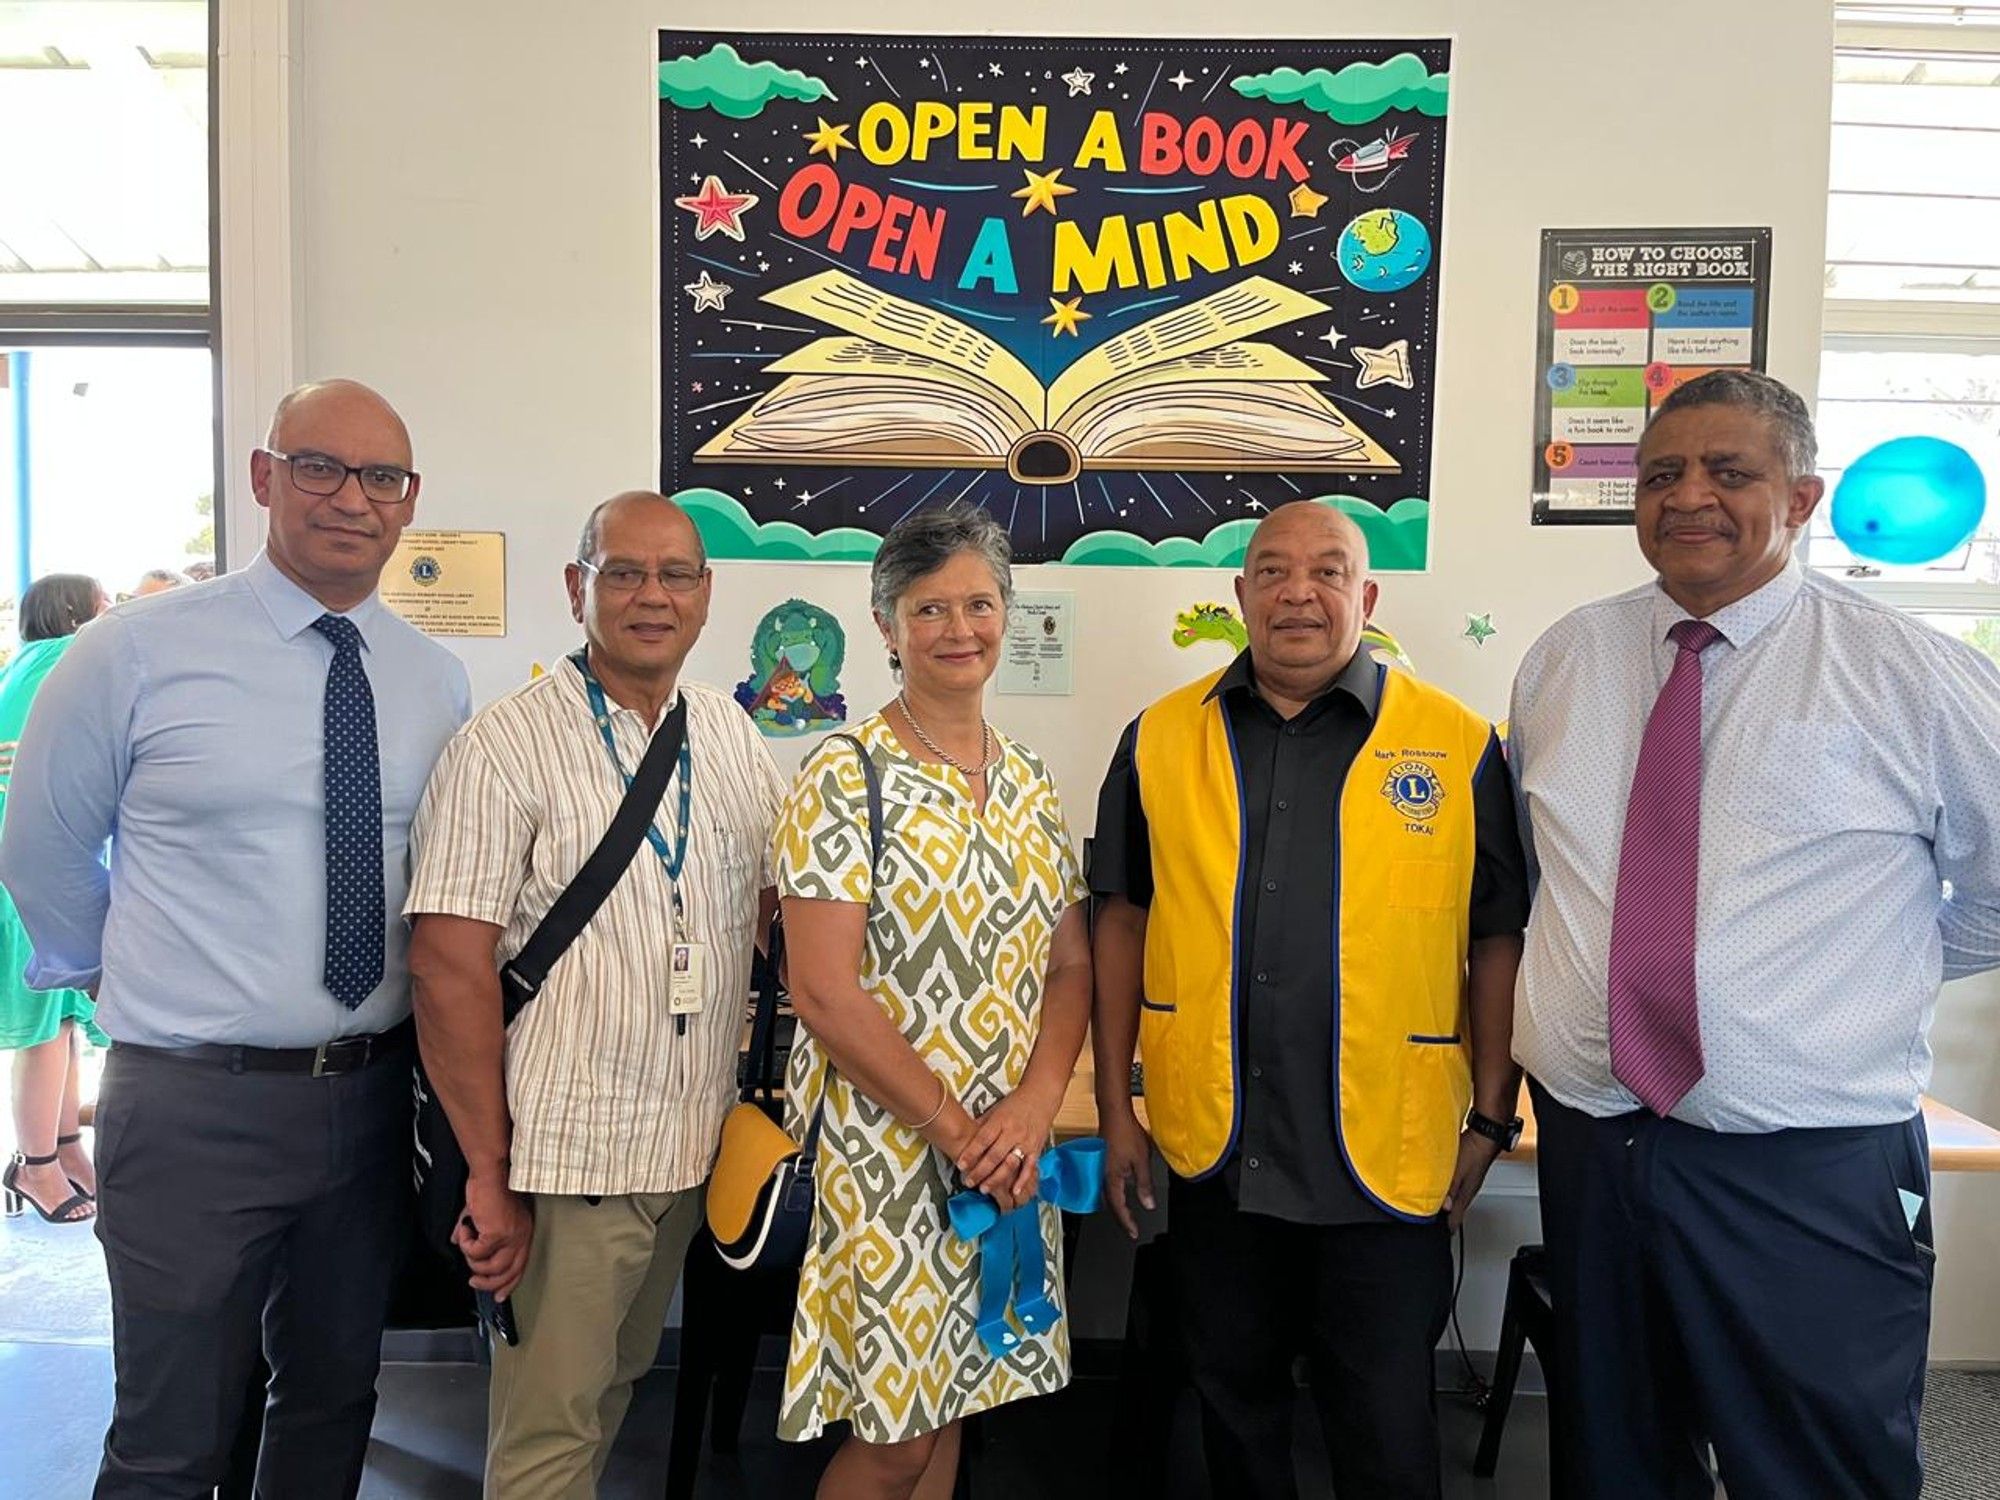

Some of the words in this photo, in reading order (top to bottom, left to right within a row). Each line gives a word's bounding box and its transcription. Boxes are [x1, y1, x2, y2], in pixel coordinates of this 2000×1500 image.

[858, 101, 1047, 165] OPEN
[1073, 110, 1127, 172] A
[1139, 112, 1310, 182] BOOK
[778, 163, 946, 280] OPEN
[957, 217, 1019, 294] A
[1052, 193, 1280, 294] MIND
[1591, 246, 1636, 261] HOW
[1640, 246, 1665, 260] TO
[1670, 246, 1744, 260] CHOOSE
[1591, 262, 1628, 276] THE
[1633, 262, 1691, 276] RIGHT
[1695, 262, 1749, 276] BOOK
[1558, 287, 1569, 309] 1
[1653, 286, 1668, 308] 2
[1710, 337, 1739, 346] anything
[1586, 347, 1625, 356] interesting?
[1668, 346, 1679, 354] like
[1682, 346, 1694, 354] this
[1696, 346, 1721, 354] before?
[1555, 366, 1569, 389] 3
[1649, 366, 1663, 387] 4
[1612, 416, 1624, 424] like
[1552, 445, 1567, 466] 5
[422, 565, 431, 576] L
[1375, 749, 1397, 759] Mark
[1401, 748, 1448, 759] Rossouw
[1393, 762, 1431, 776] LIONS
[1407, 778, 1426, 799] L
